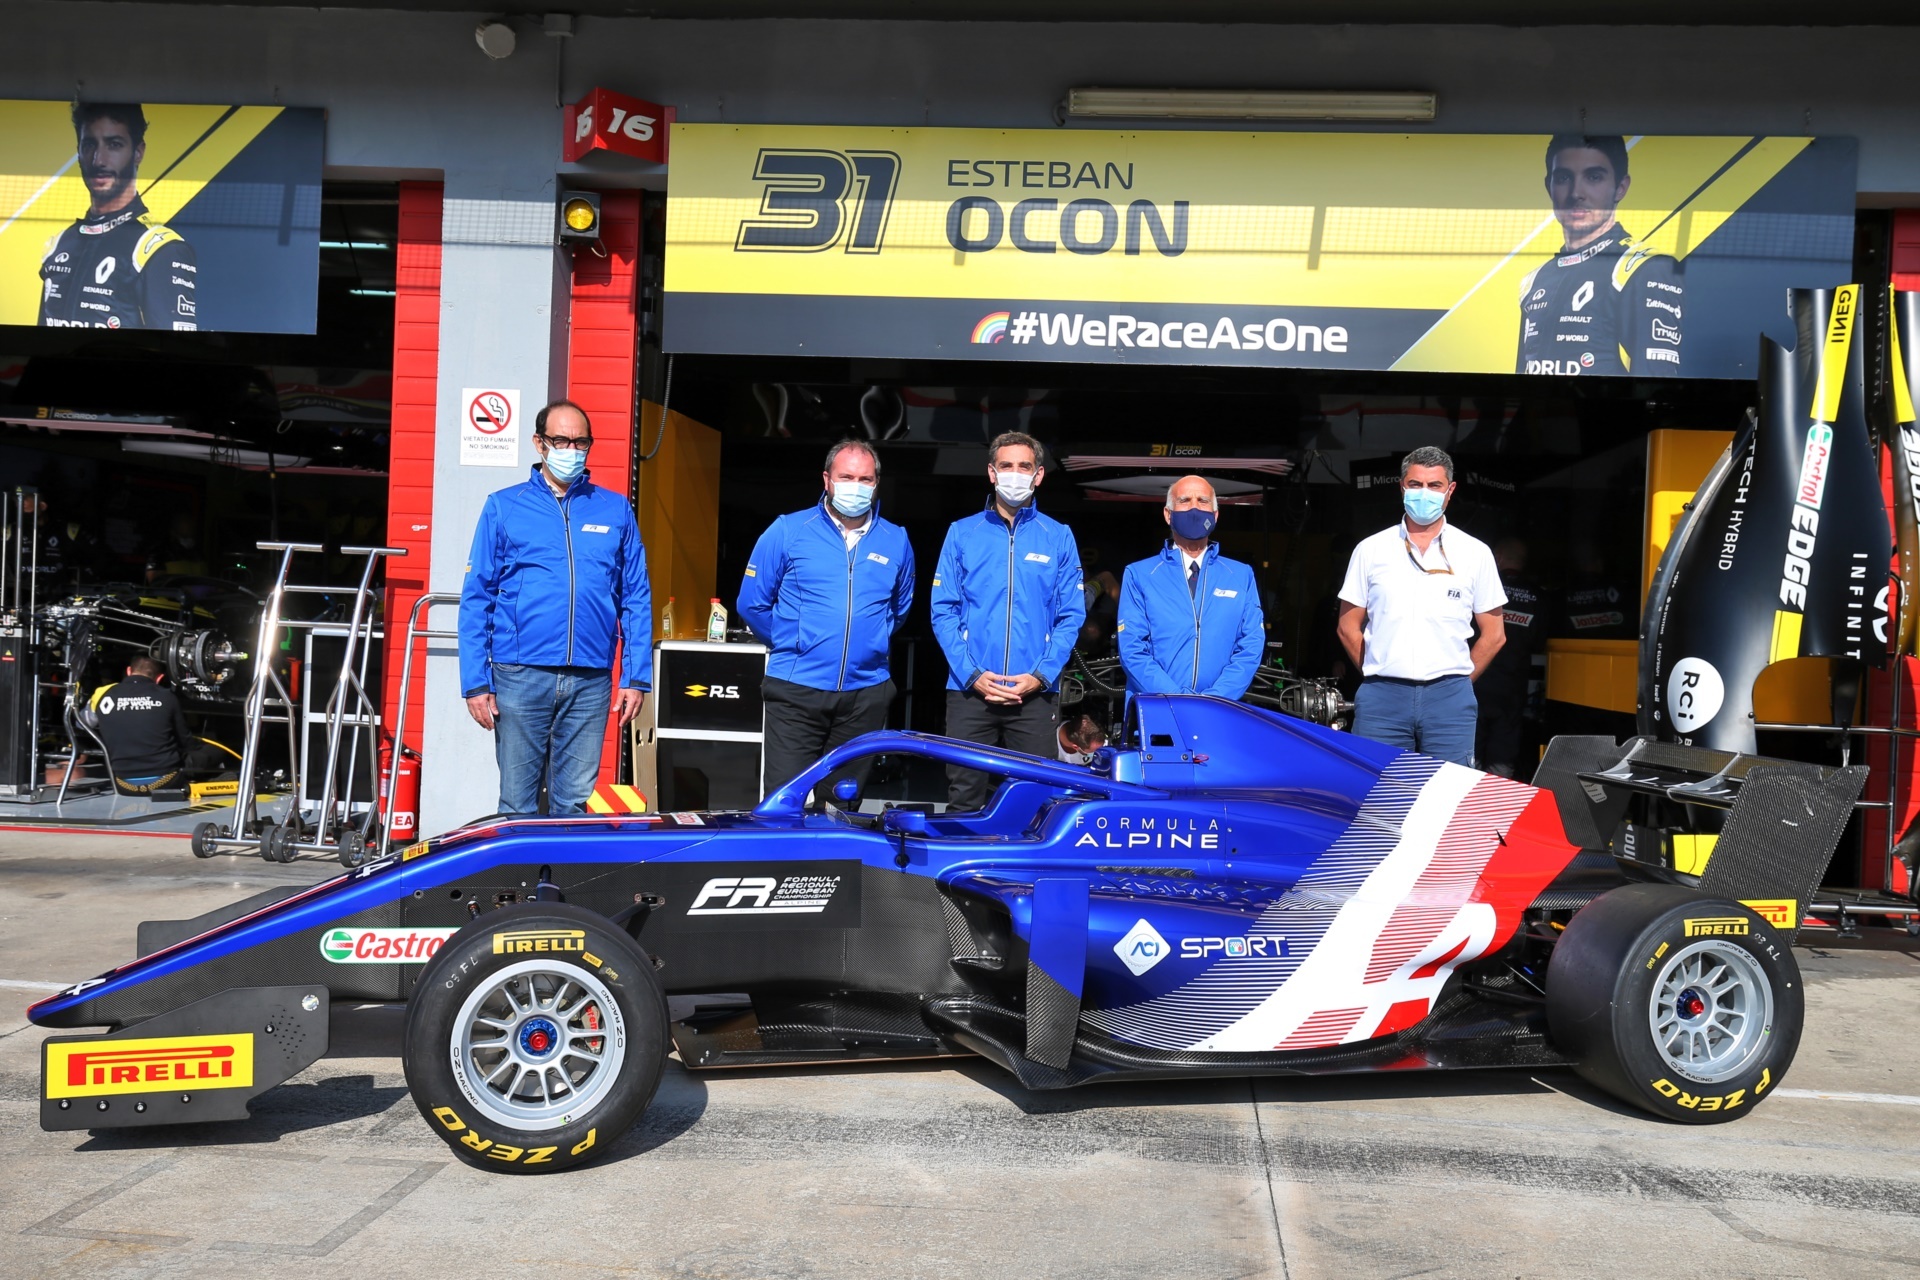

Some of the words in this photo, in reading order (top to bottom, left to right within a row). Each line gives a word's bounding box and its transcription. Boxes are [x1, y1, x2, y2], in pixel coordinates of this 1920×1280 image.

[607, 108, 656, 141] 16
[947, 160, 1134, 190] ESTEBAN
[734, 148, 901, 254] 31
[946, 196, 1189, 257] OCON
[83, 286, 114, 296] RENAULT
[1010, 311, 1348, 353] #WeRaceAsOne
[1556, 334, 1566, 342] DP
[1566, 334, 1589, 342] WORLD
[35, 407, 49, 419] 3
[53, 412, 98, 420] RICCIARDO
[1150, 443, 1168, 456] 31
[1373, 475, 1401, 485] Micro
[1479, 476, 1516, 493] Microsoft
[1801, 444, 1827, 504] Castrol
[1718, 510, 1744, 571] HYBRID
[1780, 504, 1820, 611] EDGE
[1503, 612, 1530, 625] astrol
[1075, 816, 1218, 831] FORMULA
[1075, 832, 1219, 849] ALPINE
[690, 877, 777, 909] FR
[776, 887, 836, 895] EUROPEAN
[1683, 917, 1749, 937] PIRELLI
[355, 932, 451, 959] Castro
[492, 929, 586, 954] PIRELLI
[1130, 941, 1160, 957] ACI
[1180, 936, 1286, 958] SPORT
[584, 1004, 599, 1046] bremo
[67, 1045, 235, 1086] PIRELLI
[458, 1071, 479, 1106] RACING
[1652, 1077, 1746, 1112] ZERO
[432, 1106, 558, 1164] ZERO
